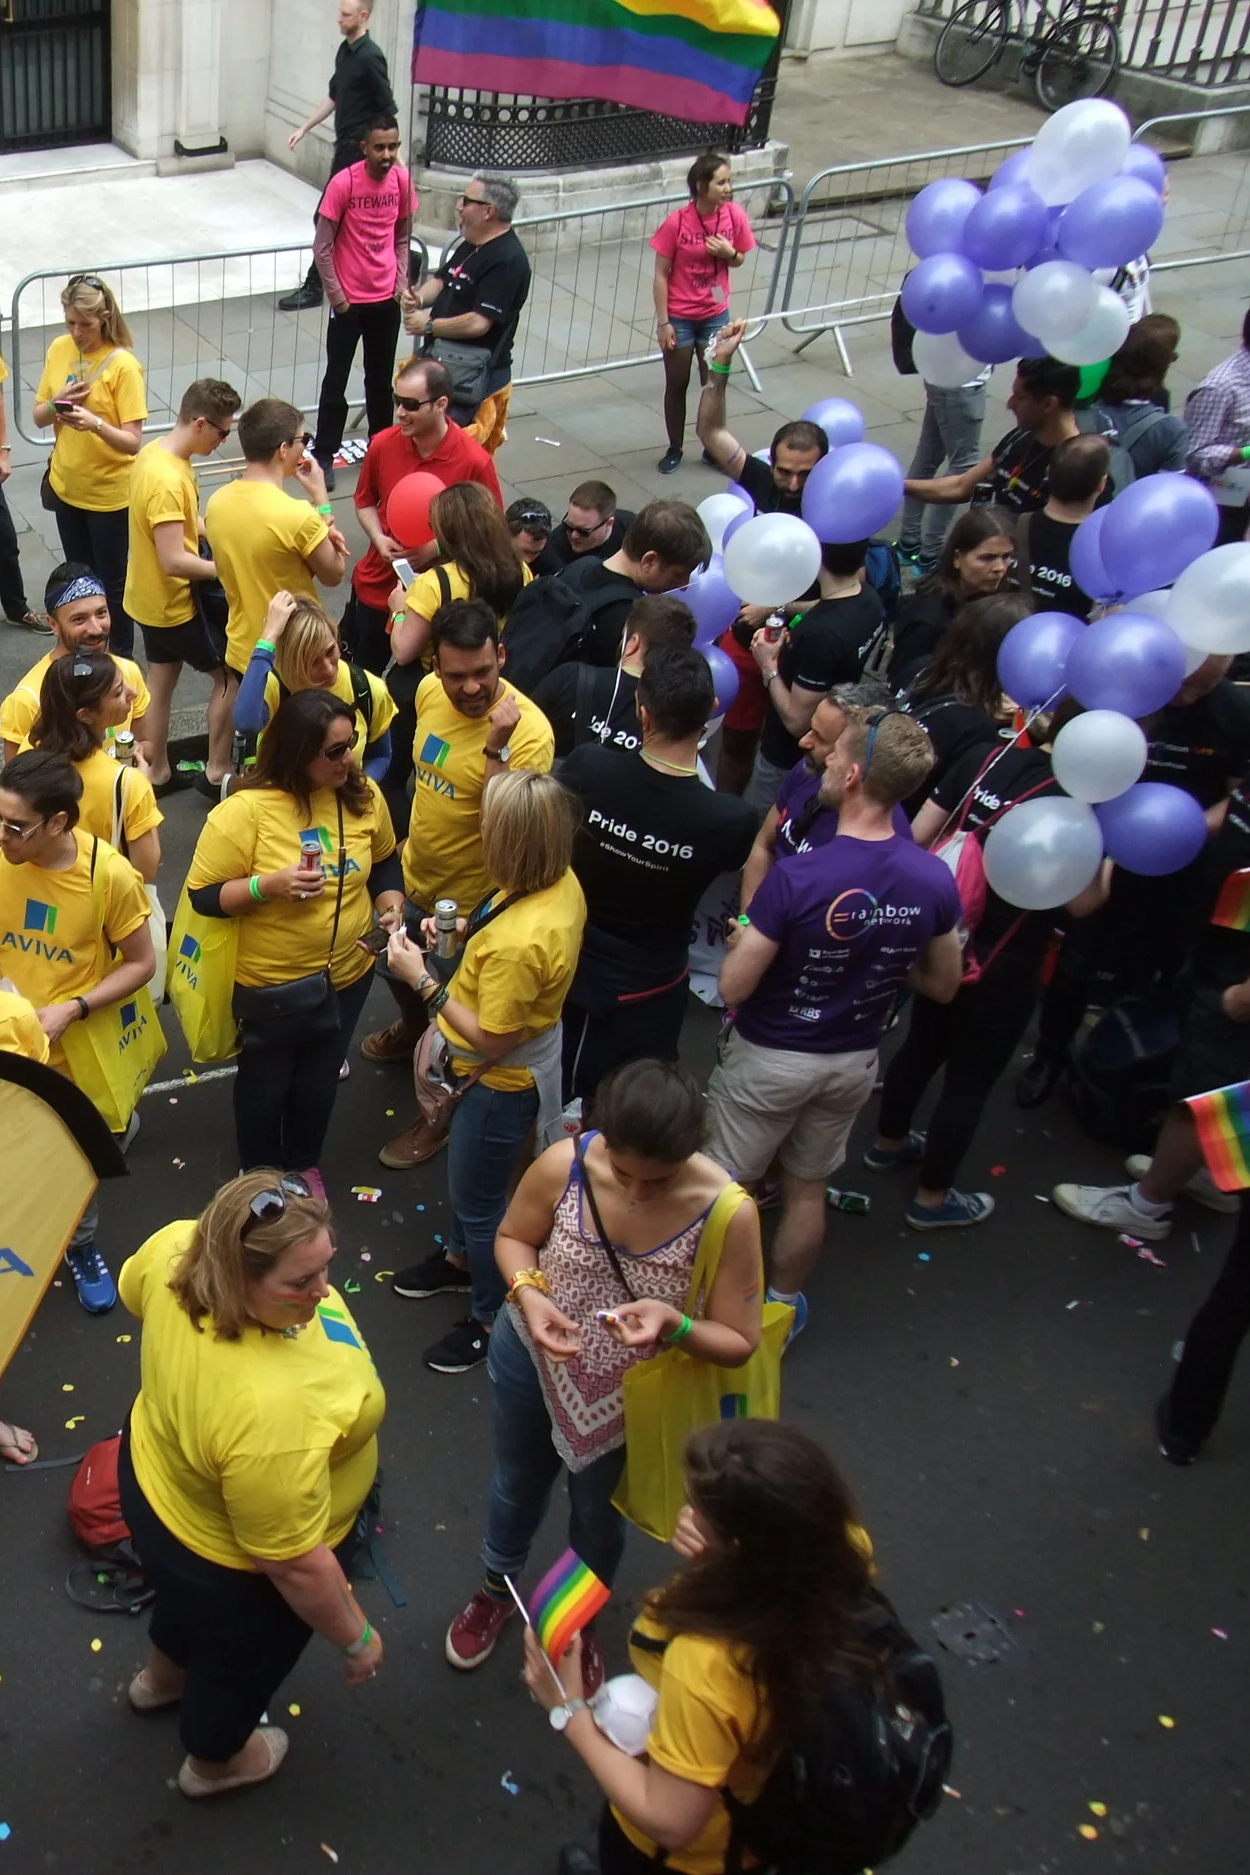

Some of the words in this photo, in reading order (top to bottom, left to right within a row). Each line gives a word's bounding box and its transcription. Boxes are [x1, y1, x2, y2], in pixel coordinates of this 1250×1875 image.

[1037, 566, 1072, 587] 2016
[613, 731, 642, 750] 20
[418, 765, 455, 800] VIVA
[973, 785, 1000, 810] ride
[588, 809, 638, 842] Pride
[641, 834, 694, 860] 2016
[599, 841, 670, 873] #ShowYourSpirit
[851, 904, 921, 920] rainbow
[1, 931, 74, 964] AVIVA
[118, 1015, 148, 1056] AVIVA
